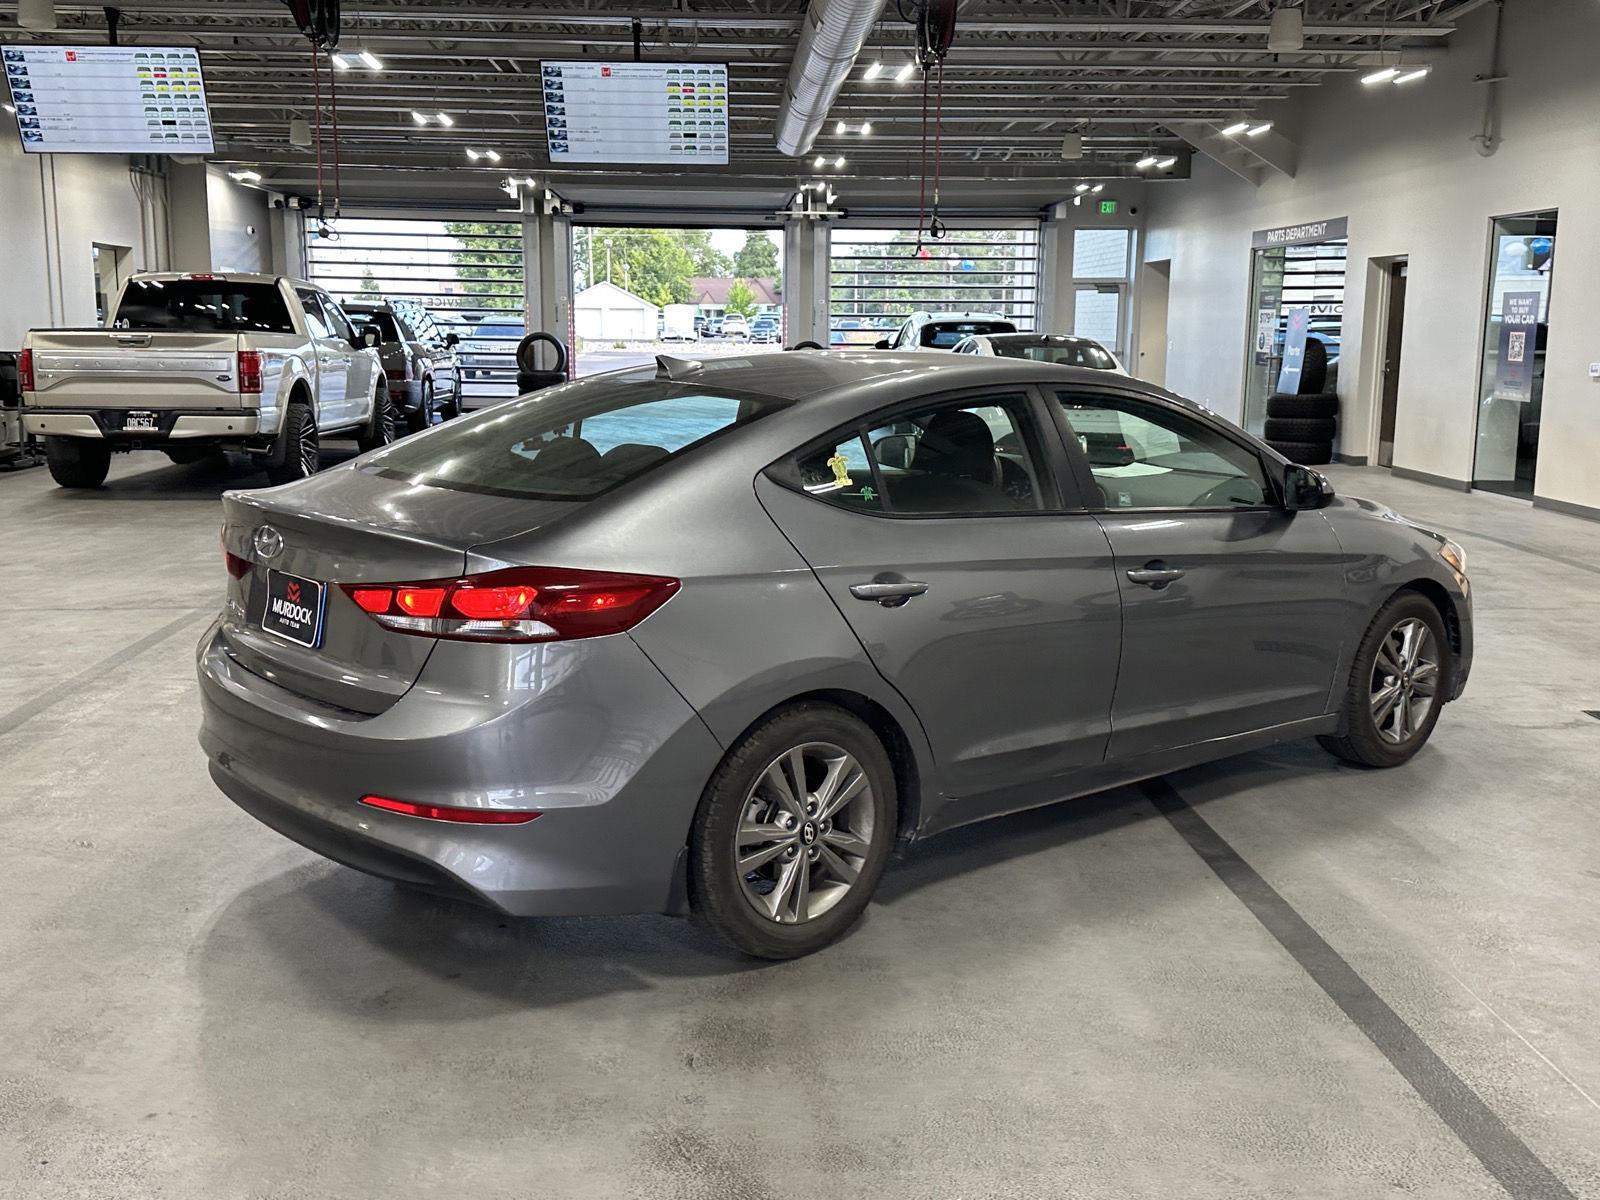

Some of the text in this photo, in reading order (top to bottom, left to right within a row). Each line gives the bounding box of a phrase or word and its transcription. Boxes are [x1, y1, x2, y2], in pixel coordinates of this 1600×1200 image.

[1101, 201, 1117, 213] EXIT
[1267, 223, 1327, 243] PARTS DEPARTMENT
[1511, 306, 1529, 314] TO BUY
[1505, 315, 1535, 324] YOUR CAR
[1287, 345, 1300, 356] Parts
[272, 597, 312, 626] MURDOCK
[279, 617, 300, 629] AUTO TEAM
